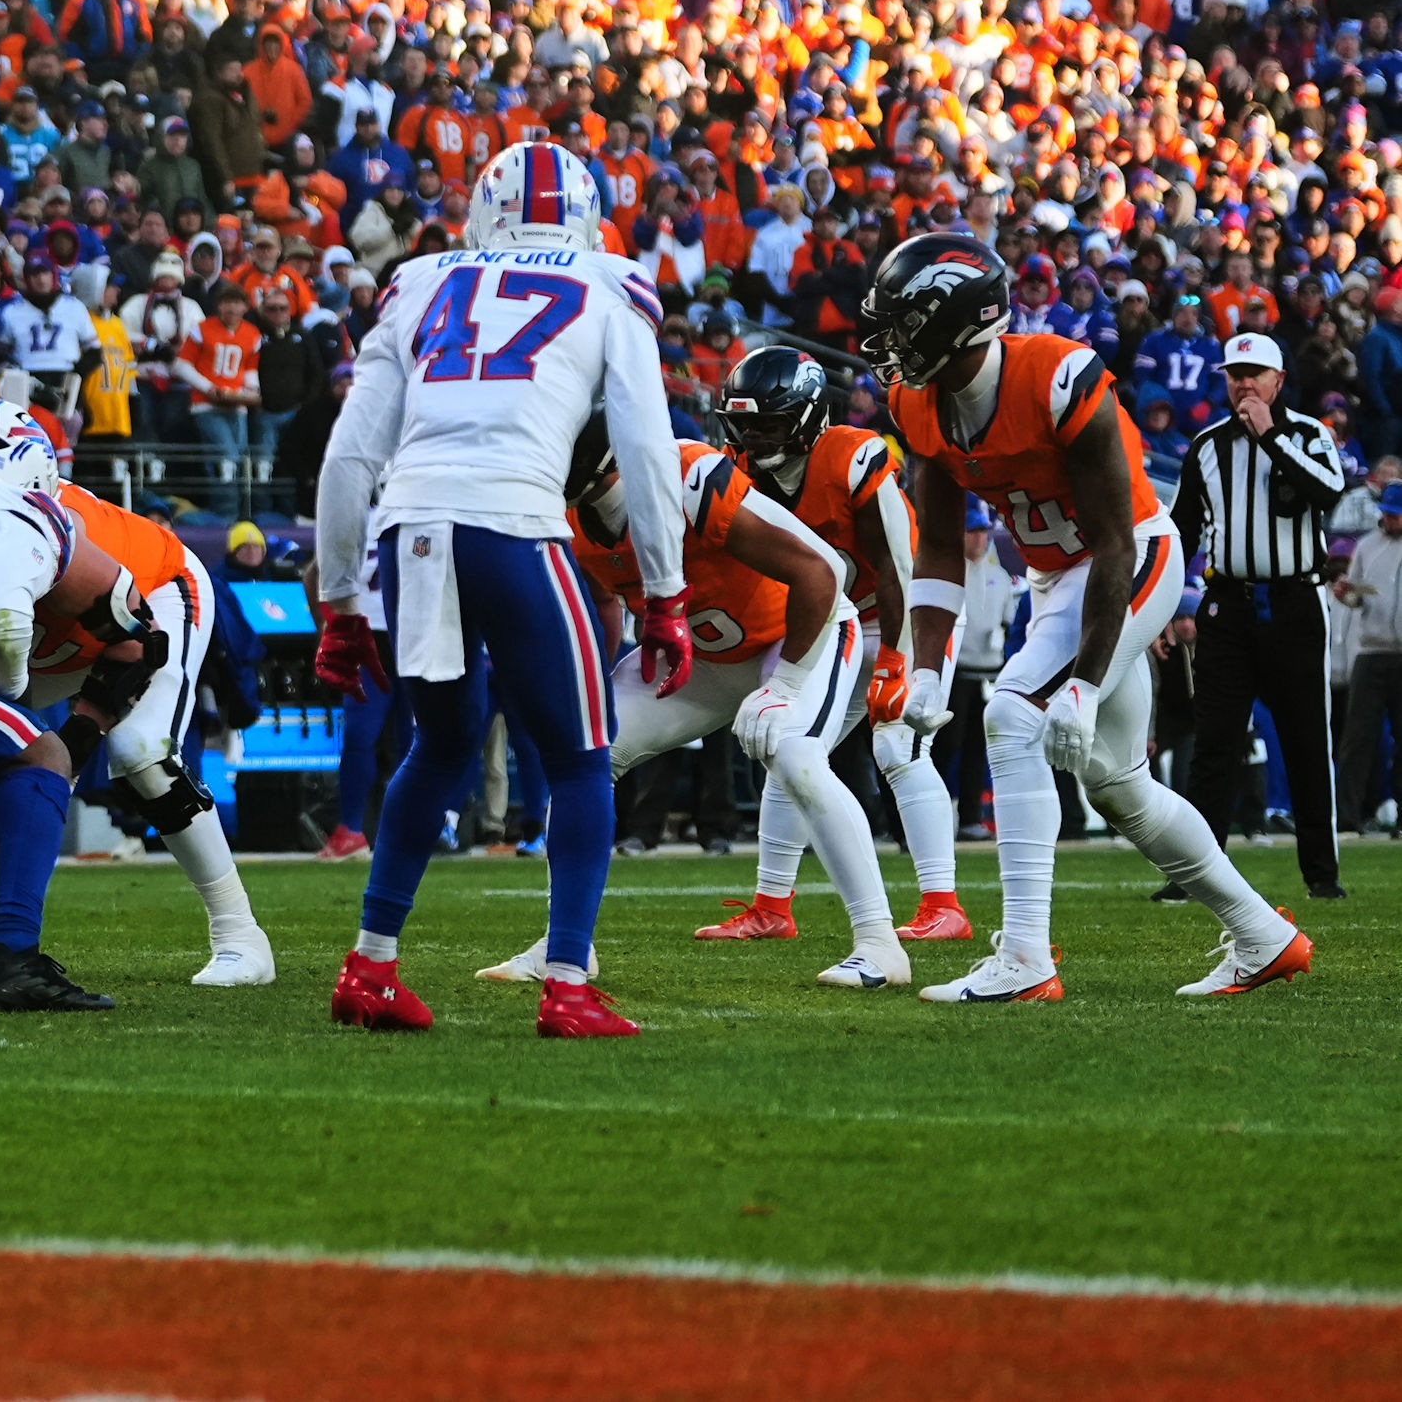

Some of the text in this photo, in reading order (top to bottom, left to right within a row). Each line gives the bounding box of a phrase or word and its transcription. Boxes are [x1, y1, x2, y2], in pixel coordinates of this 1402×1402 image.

[436, 121, 463, 154] 18
[29, 322, 63, 353] 17
[411, 266, 589, 382] 47
[214, 343, 243, 379] 10
[1168, 352, 1206, 391] 17
[1001, 489, 1085, 557] 4
